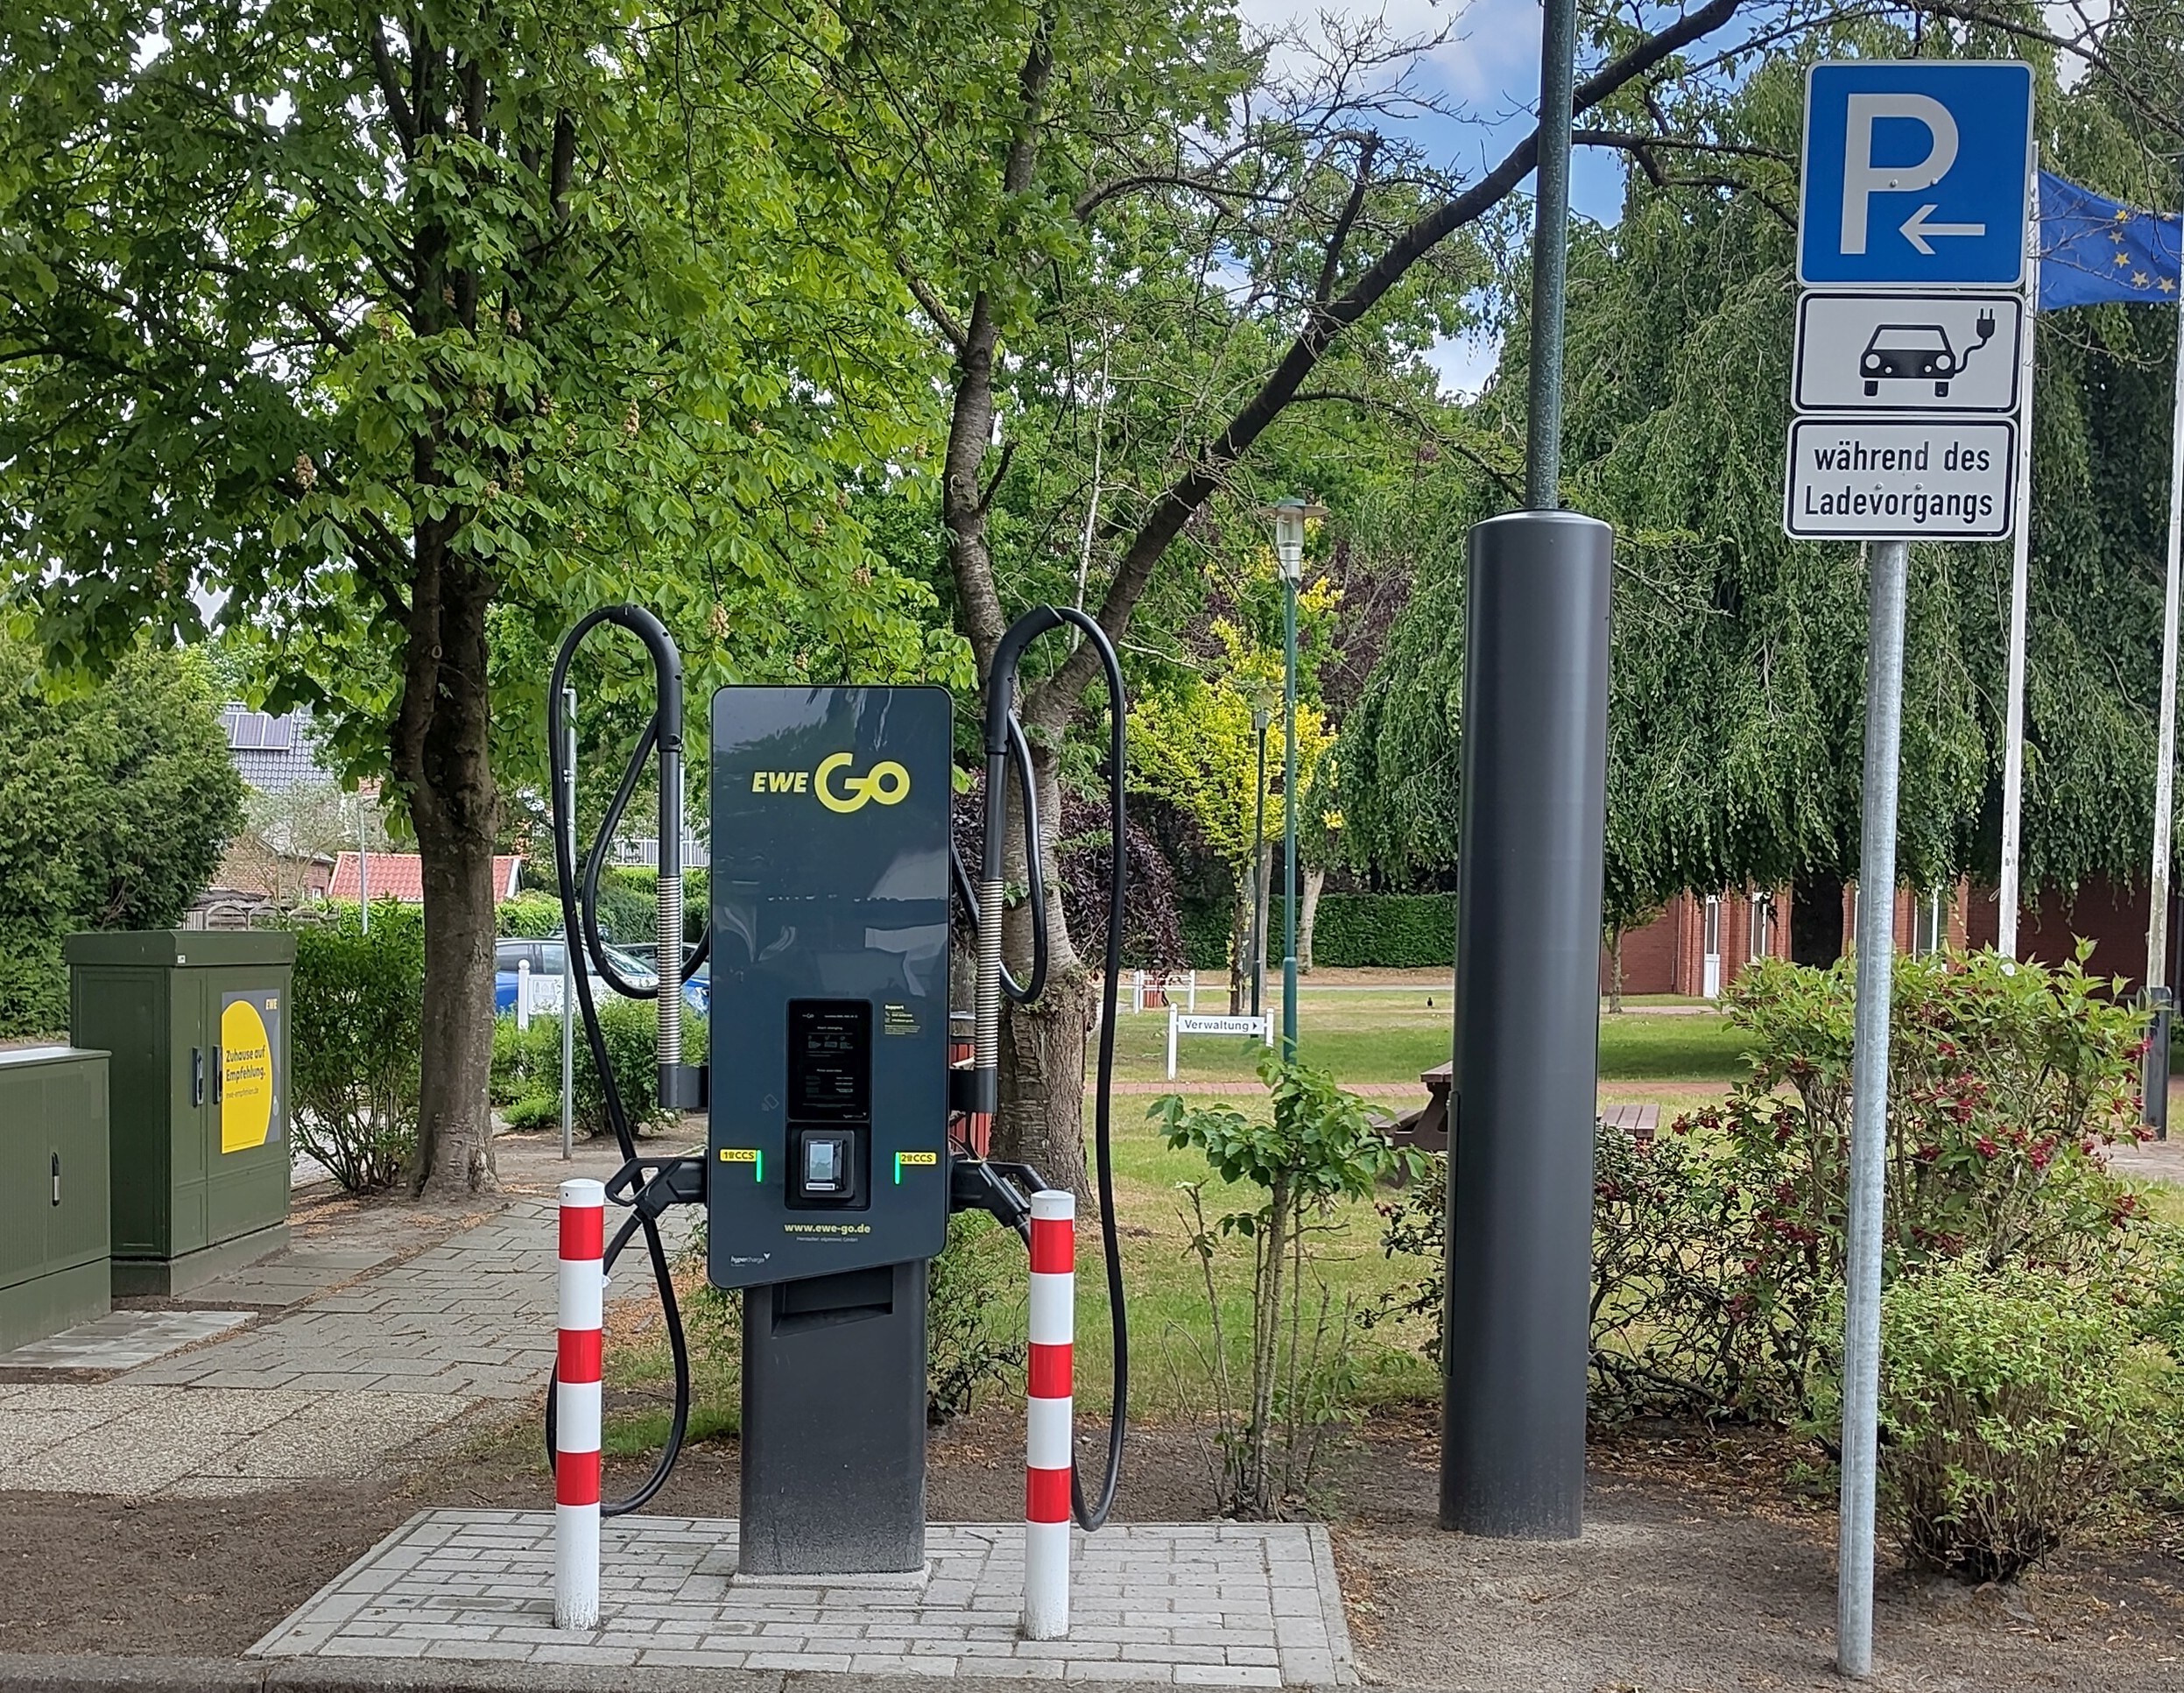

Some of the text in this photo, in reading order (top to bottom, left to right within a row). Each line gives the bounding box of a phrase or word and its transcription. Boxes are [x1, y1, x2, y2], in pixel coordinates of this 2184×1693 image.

[1840, 93, 1959, 255] P
[1814, 440, 1990, 471] während des
[1804, 484, 1993, 524] Ladevorgangs
[751, 772, 809, 793] EWE
[265, 998, 278, 1010] EWE
[1184, 1019, 1250, 1033] Verwaltung
[226, 1044, 266, 1063] Zuhause auf
[226, 1064, 266, 1084] Empfehlung.
[784, 1223, 871, 1236] www.ewe-go.de
